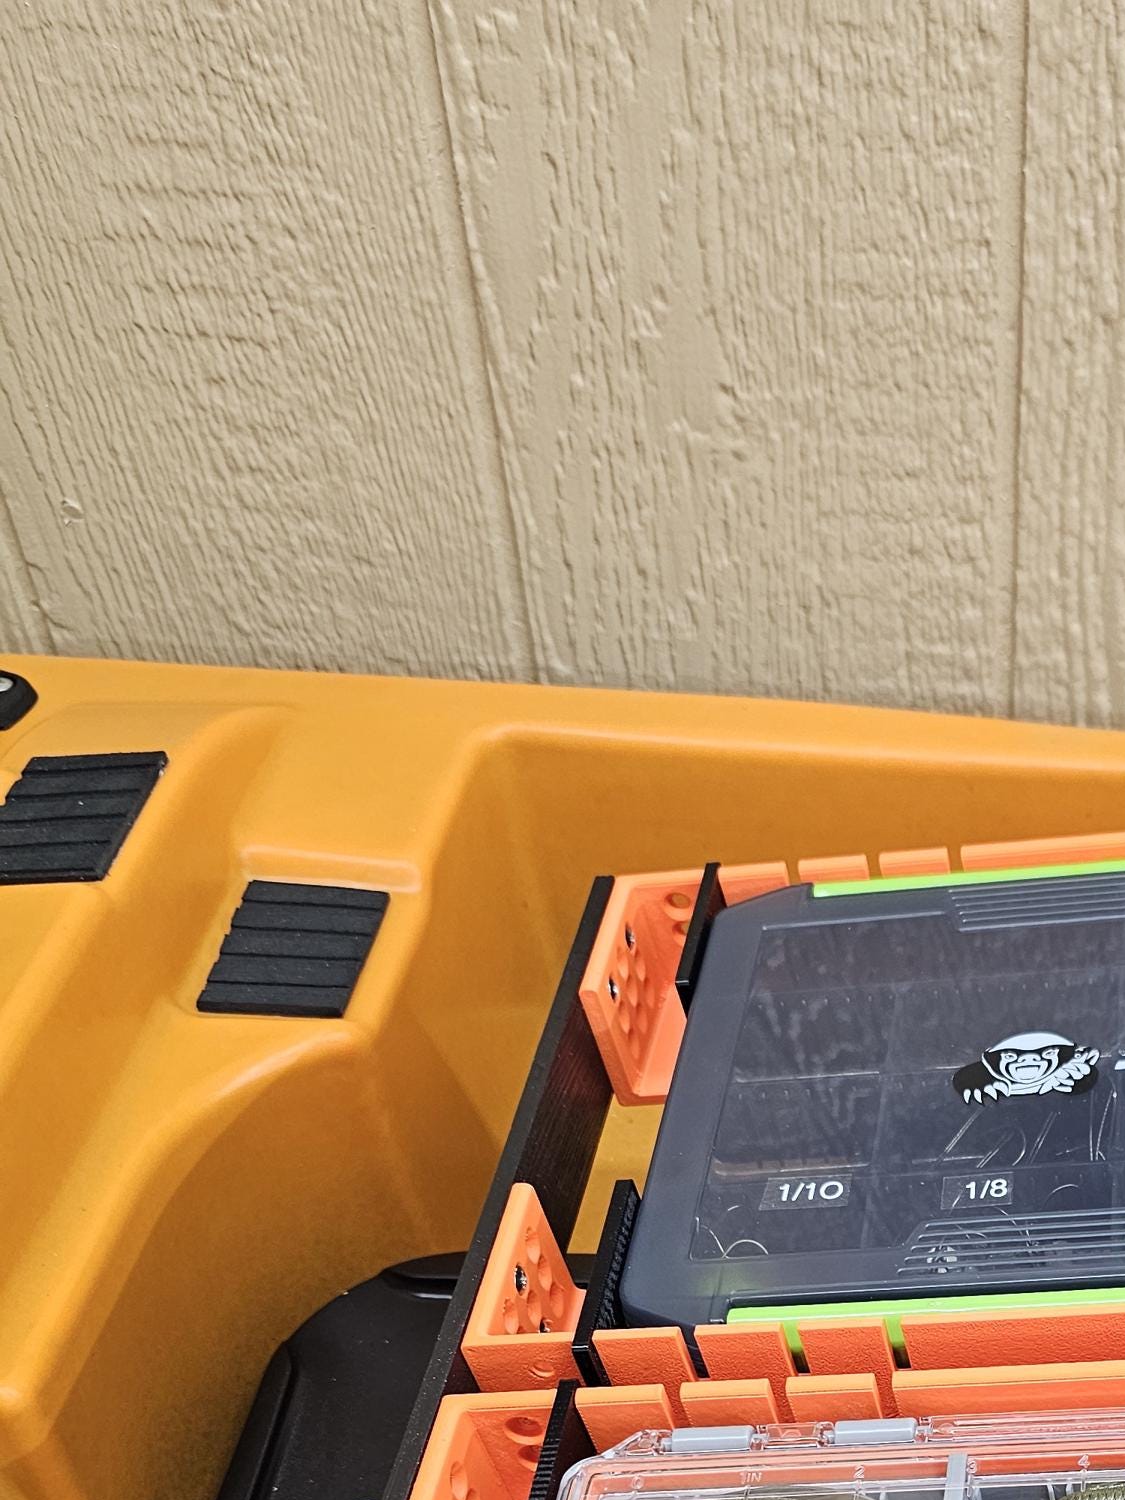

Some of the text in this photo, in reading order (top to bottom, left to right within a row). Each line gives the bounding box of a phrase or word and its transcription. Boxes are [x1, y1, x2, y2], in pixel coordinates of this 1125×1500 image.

[778, 1180, 845, 1202] 1/10
[965, 1178, 1008, 1200] 1/8
[854, 1464, 866, 1480] 2
[1078, 1454, 1090, 1468] 4
